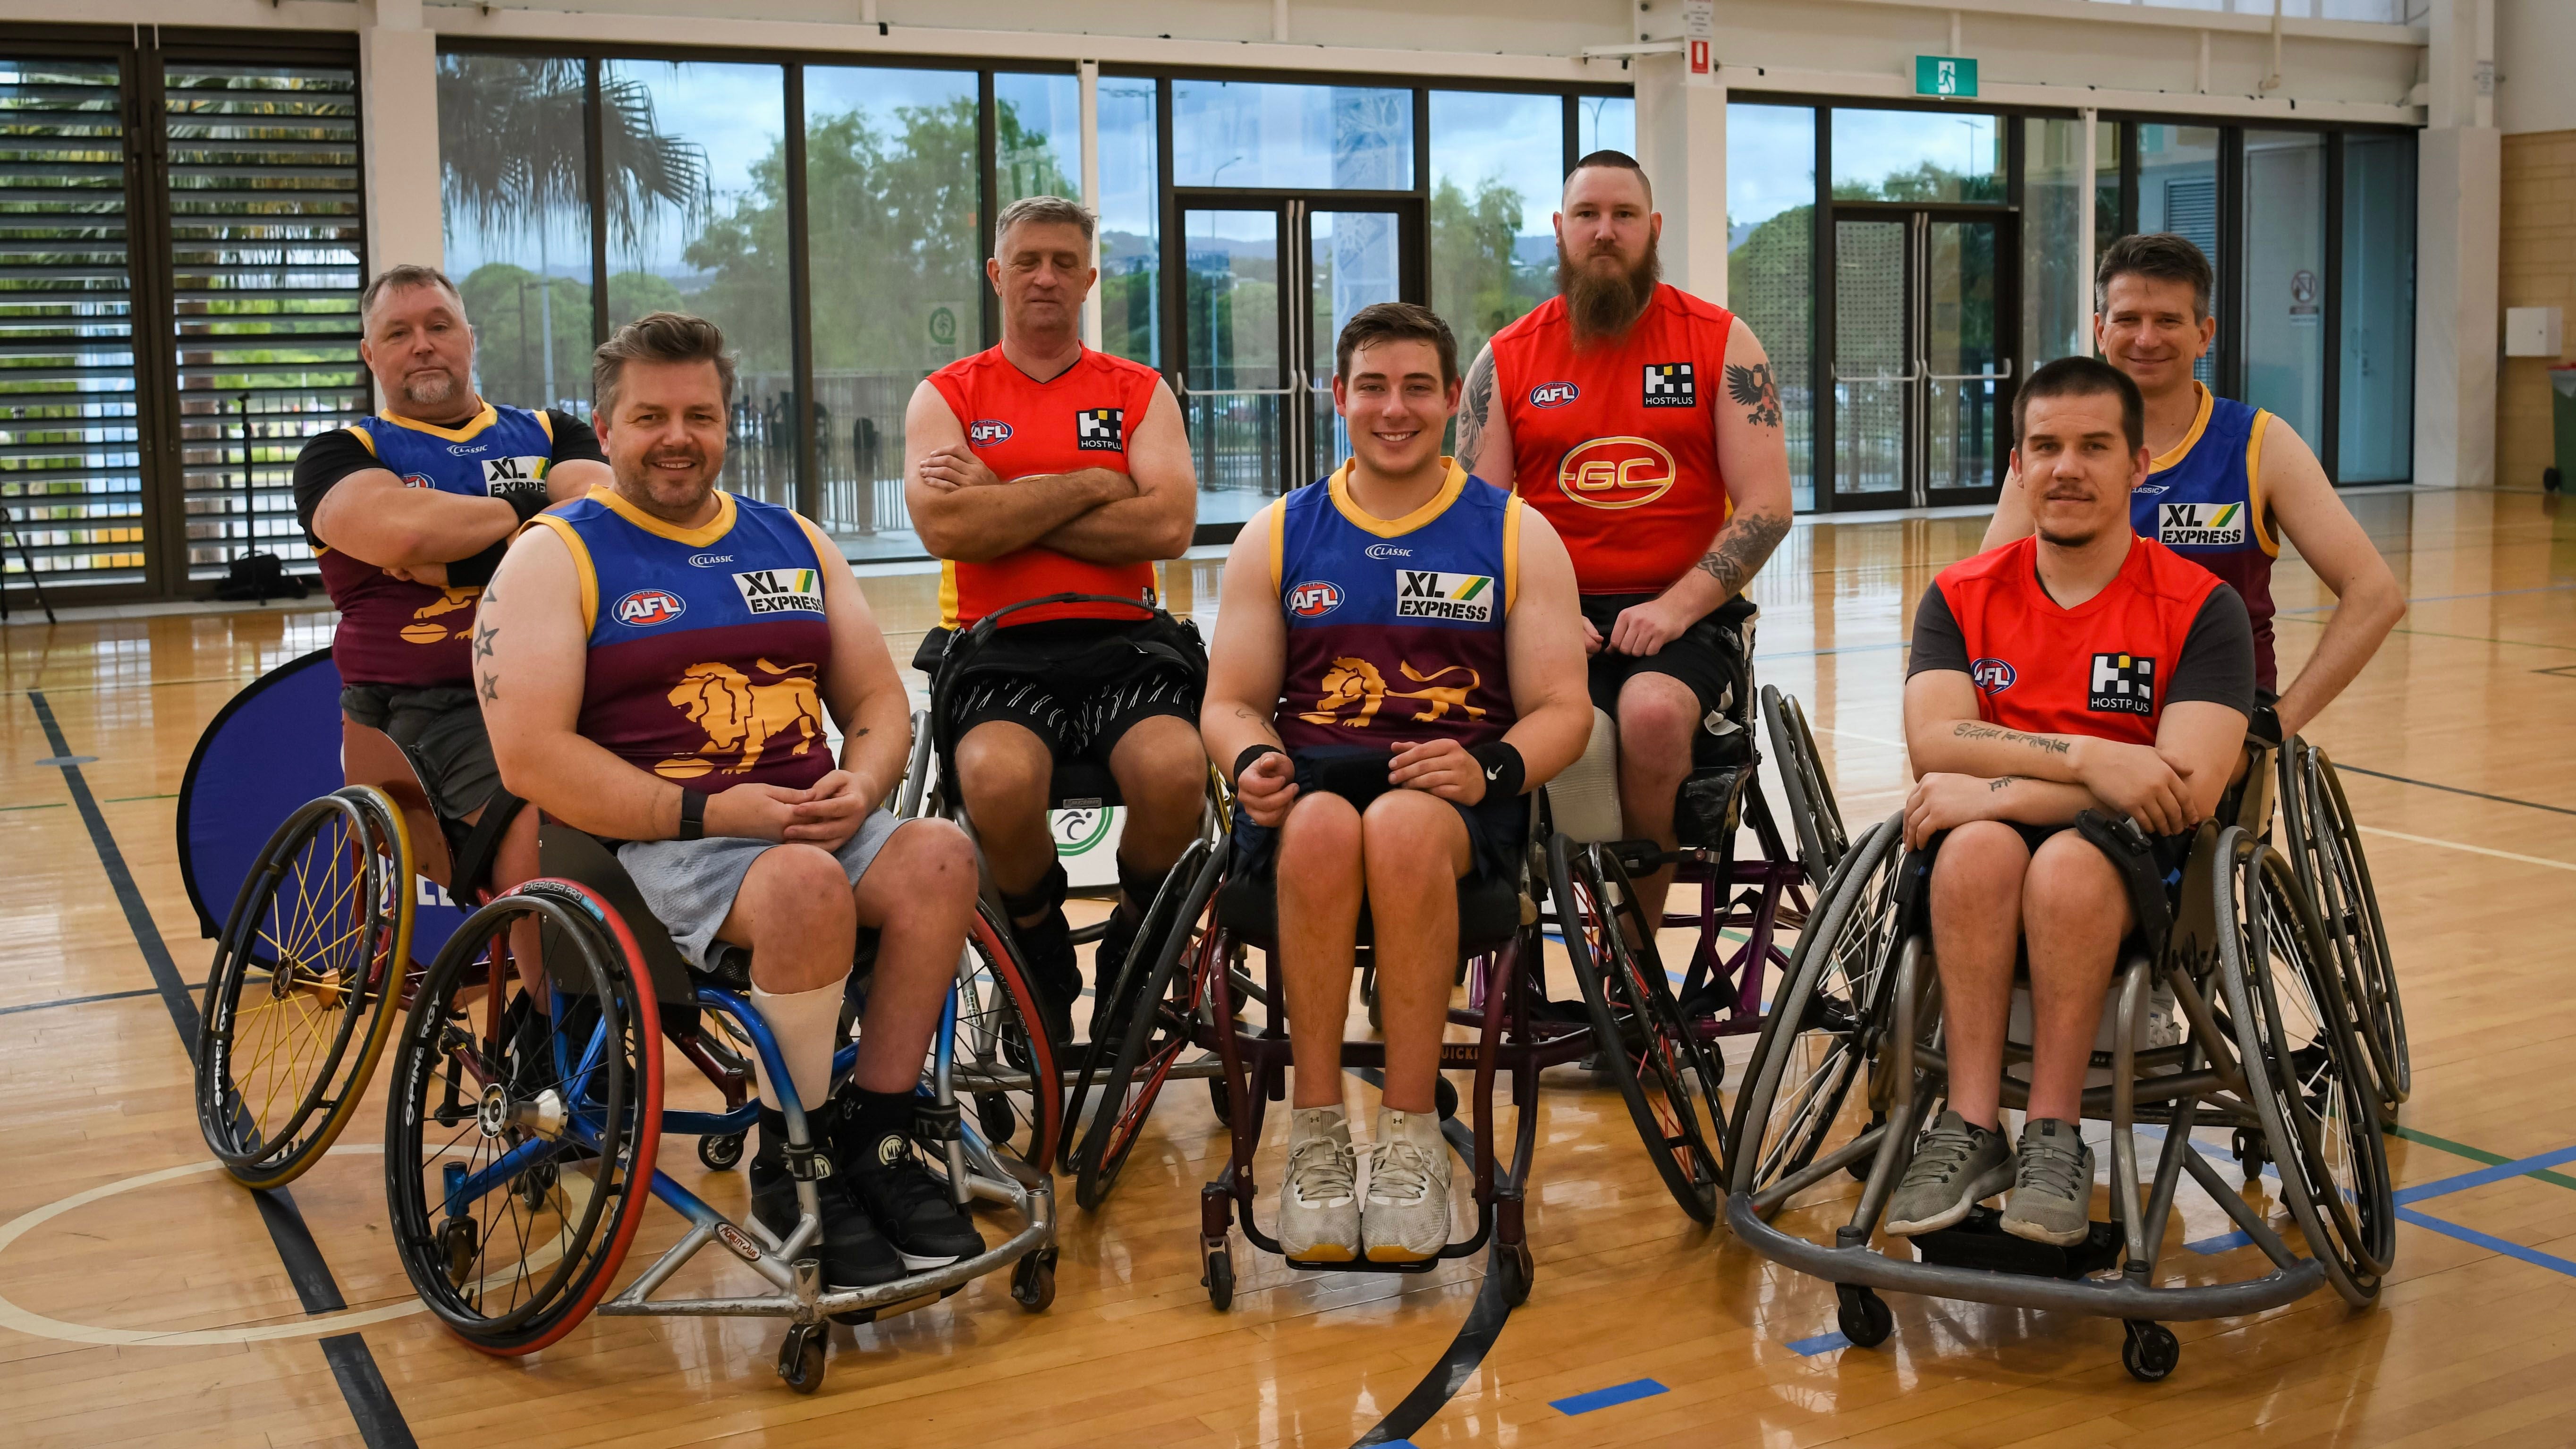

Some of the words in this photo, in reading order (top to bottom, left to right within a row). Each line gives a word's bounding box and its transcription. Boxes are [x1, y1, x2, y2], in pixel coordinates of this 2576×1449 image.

[1534, 386, 1575, 403] AFL
[1645, 397, 1693, 405] HOSTPLUS
[971, 425, 1008, 440] AFL
[453, 445, 488, 454] CLASSIC
[1081, 440, 1121, 450] HOSTPLU
[489, 458, 527, 481] XL
[1576, 457, 1668, 491] GC
[491, 482, 546, 497] EXPRE
[2162, 505, 2203, 527] XL
[2161, 529, 2241, 544] EXPRESS
[697, 554, 734, 565] CLASSIC
[1373, 546, 1413, 557] CLASSIC
[741, 571, 789, 597] XL
[1400, 571, 1445, 598] XL
[750, 595, 824, 613] EXPRESS
[1291, 588, 1338, 610] AFL
[621, 595, 682, 621] AFL
[1398, 600, 1488, 621] EXPRESS
[2091, 697, 2150, 713] HOSTPUS
[523, 881, 566, 892] EXERACER
[565, 887, 583, 901] PRO
[1014, 1009, 1030, 1036] PRO
[214, 1001, 229, 1107] SPINEGY
[1441, 1046, 1478, 1059] UICKI
[816, 1163, 828, 1178] AX
